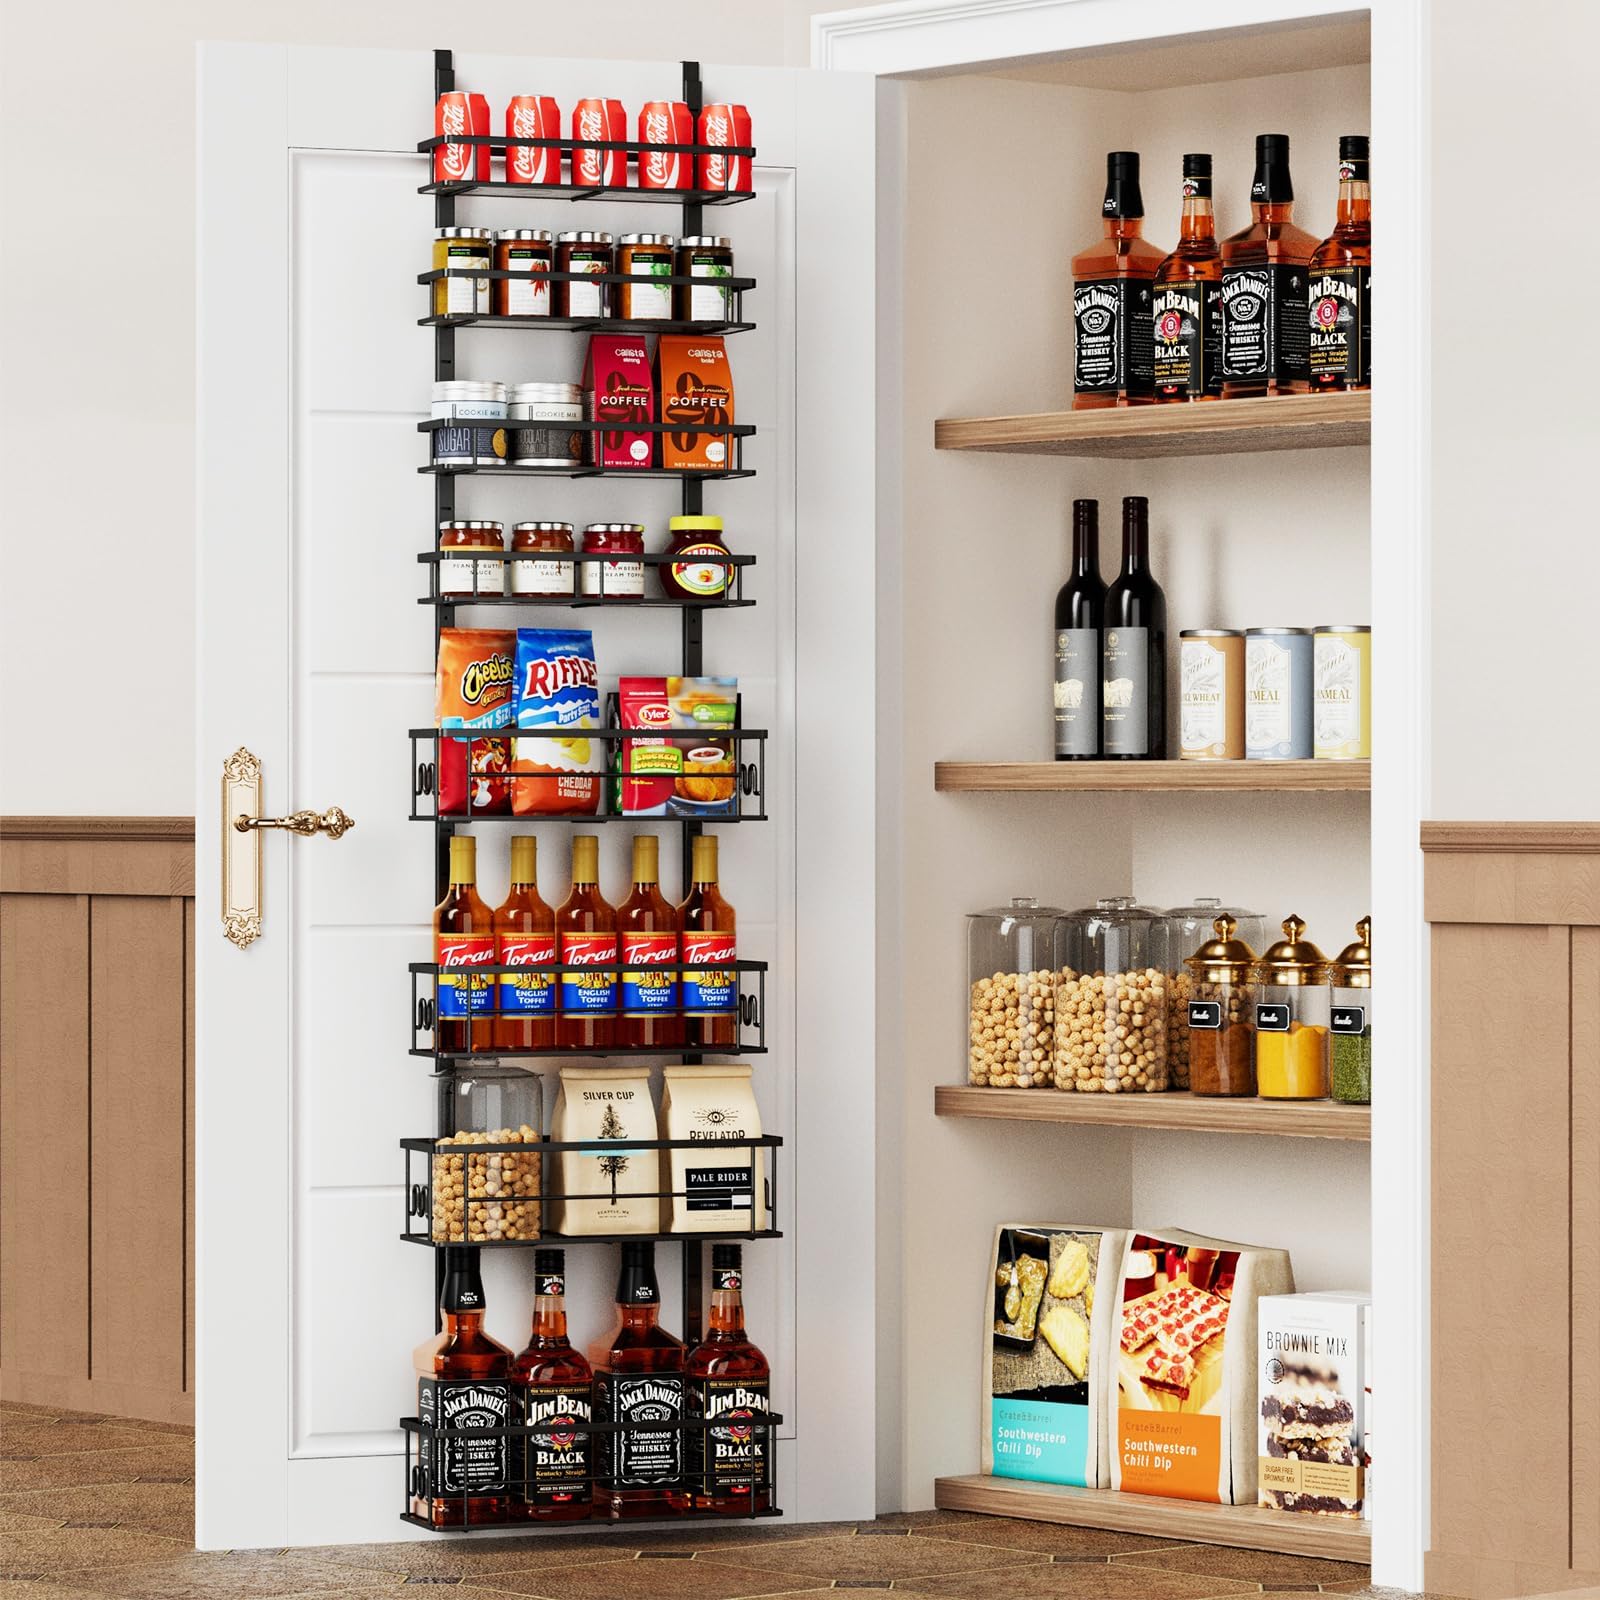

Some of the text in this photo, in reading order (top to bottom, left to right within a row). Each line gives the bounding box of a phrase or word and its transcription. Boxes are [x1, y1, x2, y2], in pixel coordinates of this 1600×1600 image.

[1222, 276, 1270, 303] JACK DANIEL'S
[1323, 276, 1357, 306] BEAM
[1074, 294, 1091, 317] JACK
[1166, 290, 1200, 320] BEAM
[1310, 332, 1348, 347] BLACK
[1155, 345, 1190, 359] BLACK
[601, 396, 648, 406] COFFEE
[670, 396, 727, 407] COFFEE
[459, 409, 488, 417] COOKIE
[438, 428, 471, 452] SUGAR
[496, 705, 513, 726] Siz
[558, 776, 592, 790] CHEDDAR
[516, 989, 548, 997] ENGLISH
[578, 989, 610, 997] ENGLISH
[699, 987, 730, 995] ENGLISH
[701, 994, 728, 1002] TOFFEE
[583, 1091, 635, 1100] SILVER CUP
[689, 1130, 746, 1141] REVELATOR
[691, 1173, 748, 1182] PALE RIDER
[1266, 1331, 1348, 1357] BROWNIE MIX
[443, 1389, 508, 1418] JACK DANIEL'S
[620, 1384, 682, 1411] JACK DANIEL'S
[706, 1388, 769, 1420] JIM BEAM
[527, 1394, 592, 1427] JIM BEAM
[998, 1427, 1067, 1444] Southwestern
[715, 1443, 763, 1457] BLACK
[997, 1441, 1042, 1458] Chili Dip
[1125, 1438, 1198, 1457] Southwestern
[455, 1452, 497, 1460] WISKEY
[536, 1451, 585, 1464] BLACK
[1124, 1453, 1172, 1471] Chili Dip
[1265, 1465, 1294, 1475] SUGAR FREE
